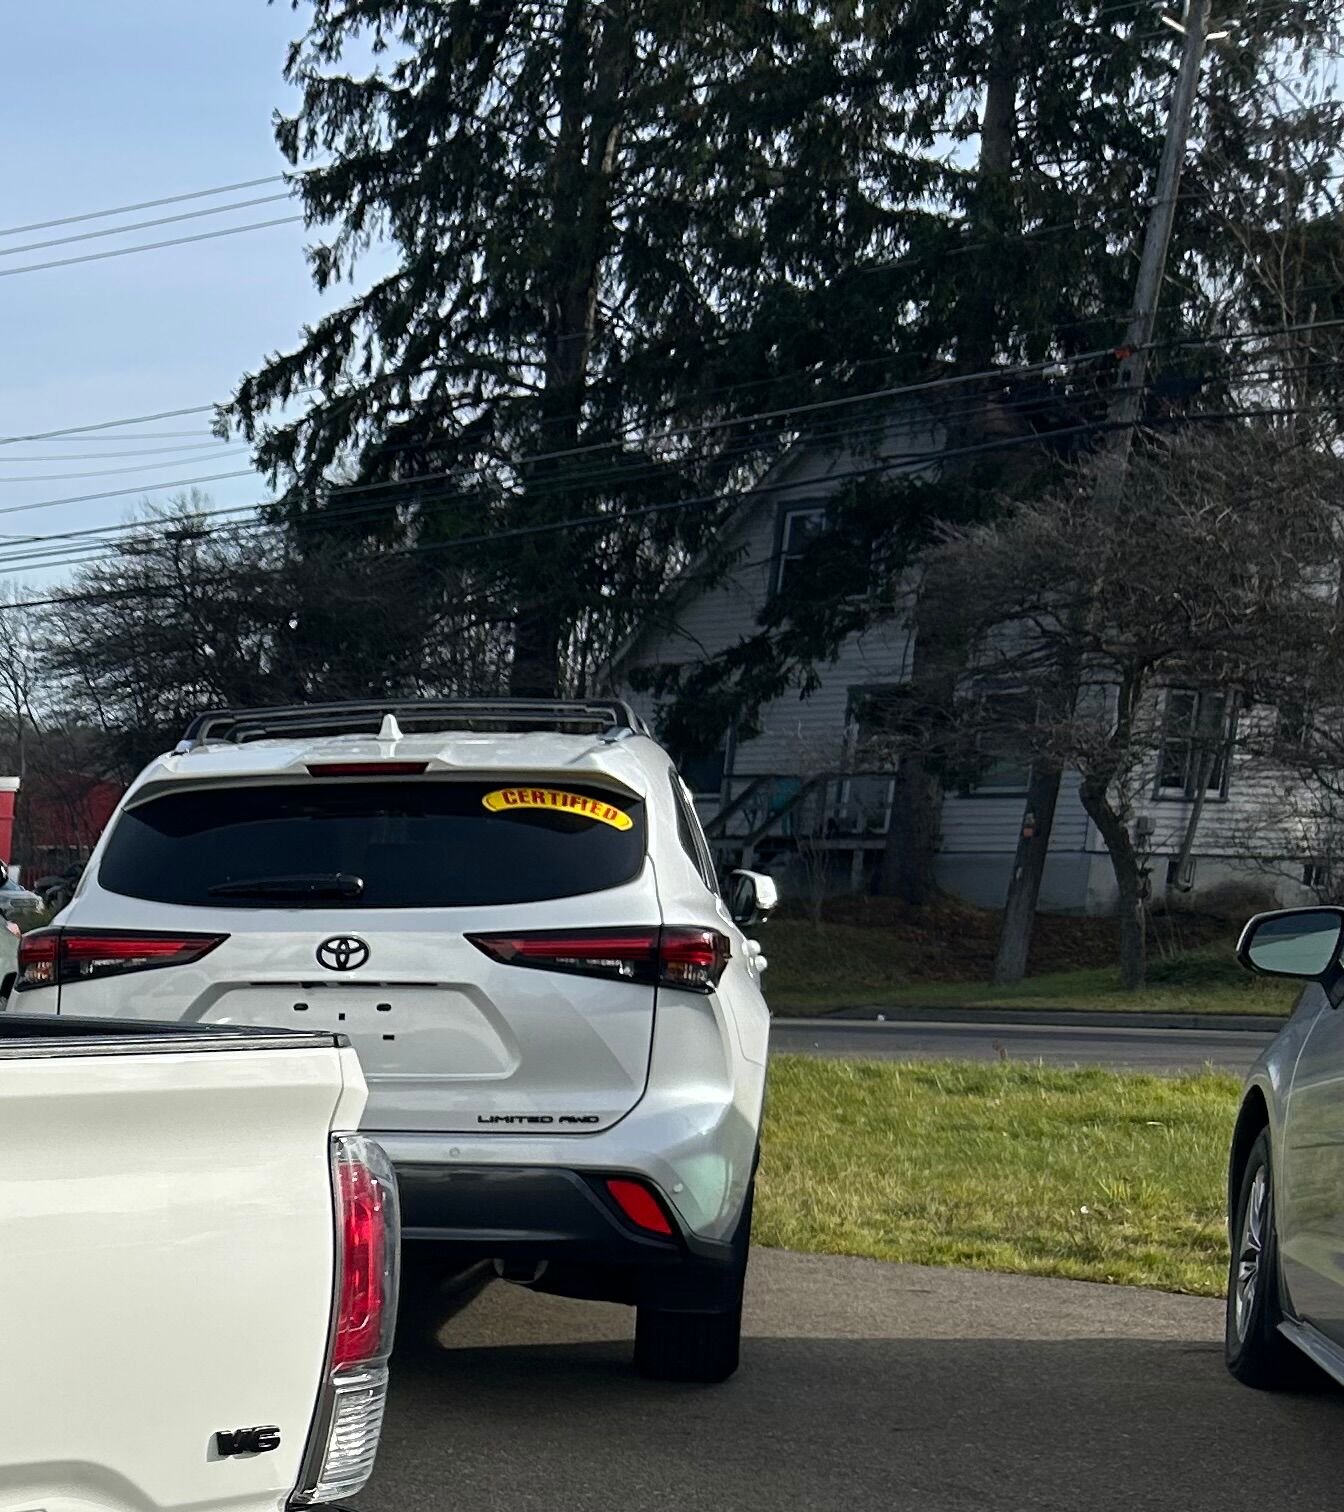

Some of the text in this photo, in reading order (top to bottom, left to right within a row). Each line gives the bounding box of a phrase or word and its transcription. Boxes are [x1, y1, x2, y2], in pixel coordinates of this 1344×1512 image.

[502, 789, 618, 821] CERTIFIED
[477, 1115, 600, 1124] LIMITED AWD
[216, 1425, 281, 1456] V6
